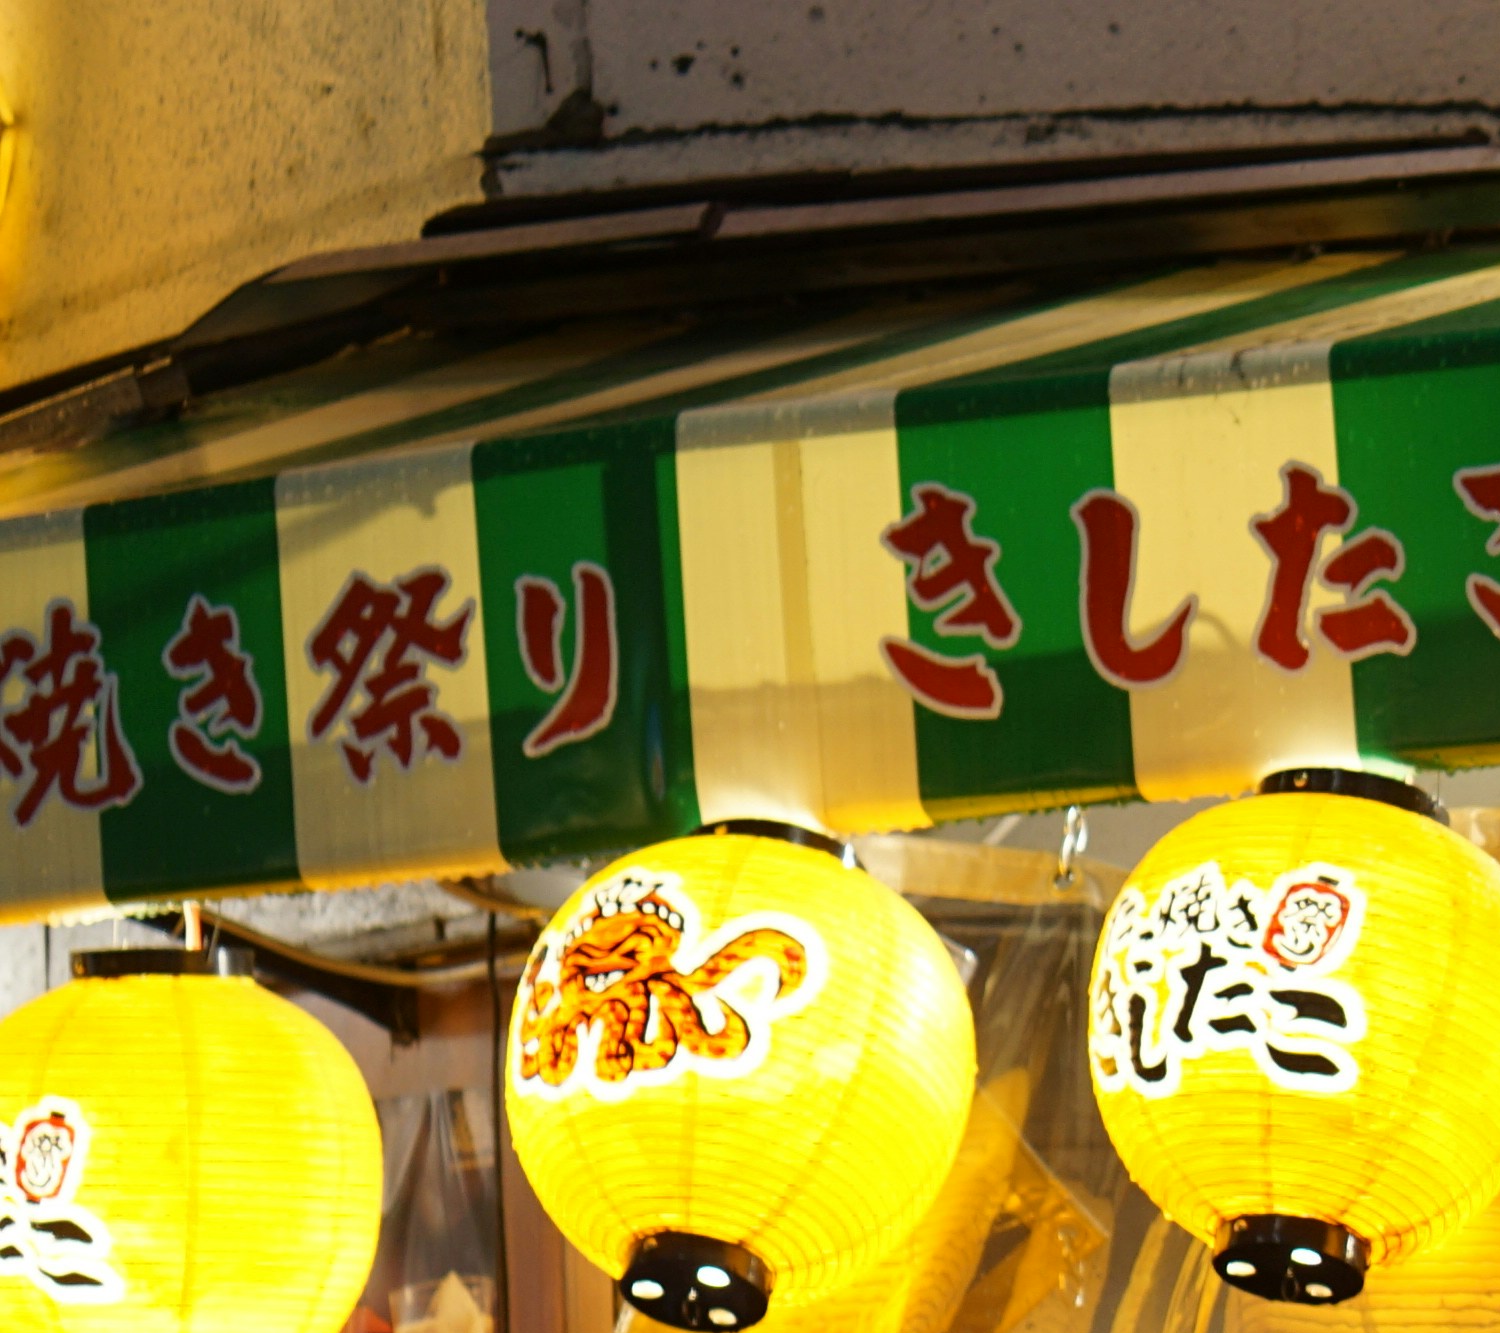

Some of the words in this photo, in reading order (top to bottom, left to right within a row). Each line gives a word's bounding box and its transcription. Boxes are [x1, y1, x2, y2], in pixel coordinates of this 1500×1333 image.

[0, 561, 619, 826] 焼き祭り
[1096, 944, 1348, 1084] きしたこ
